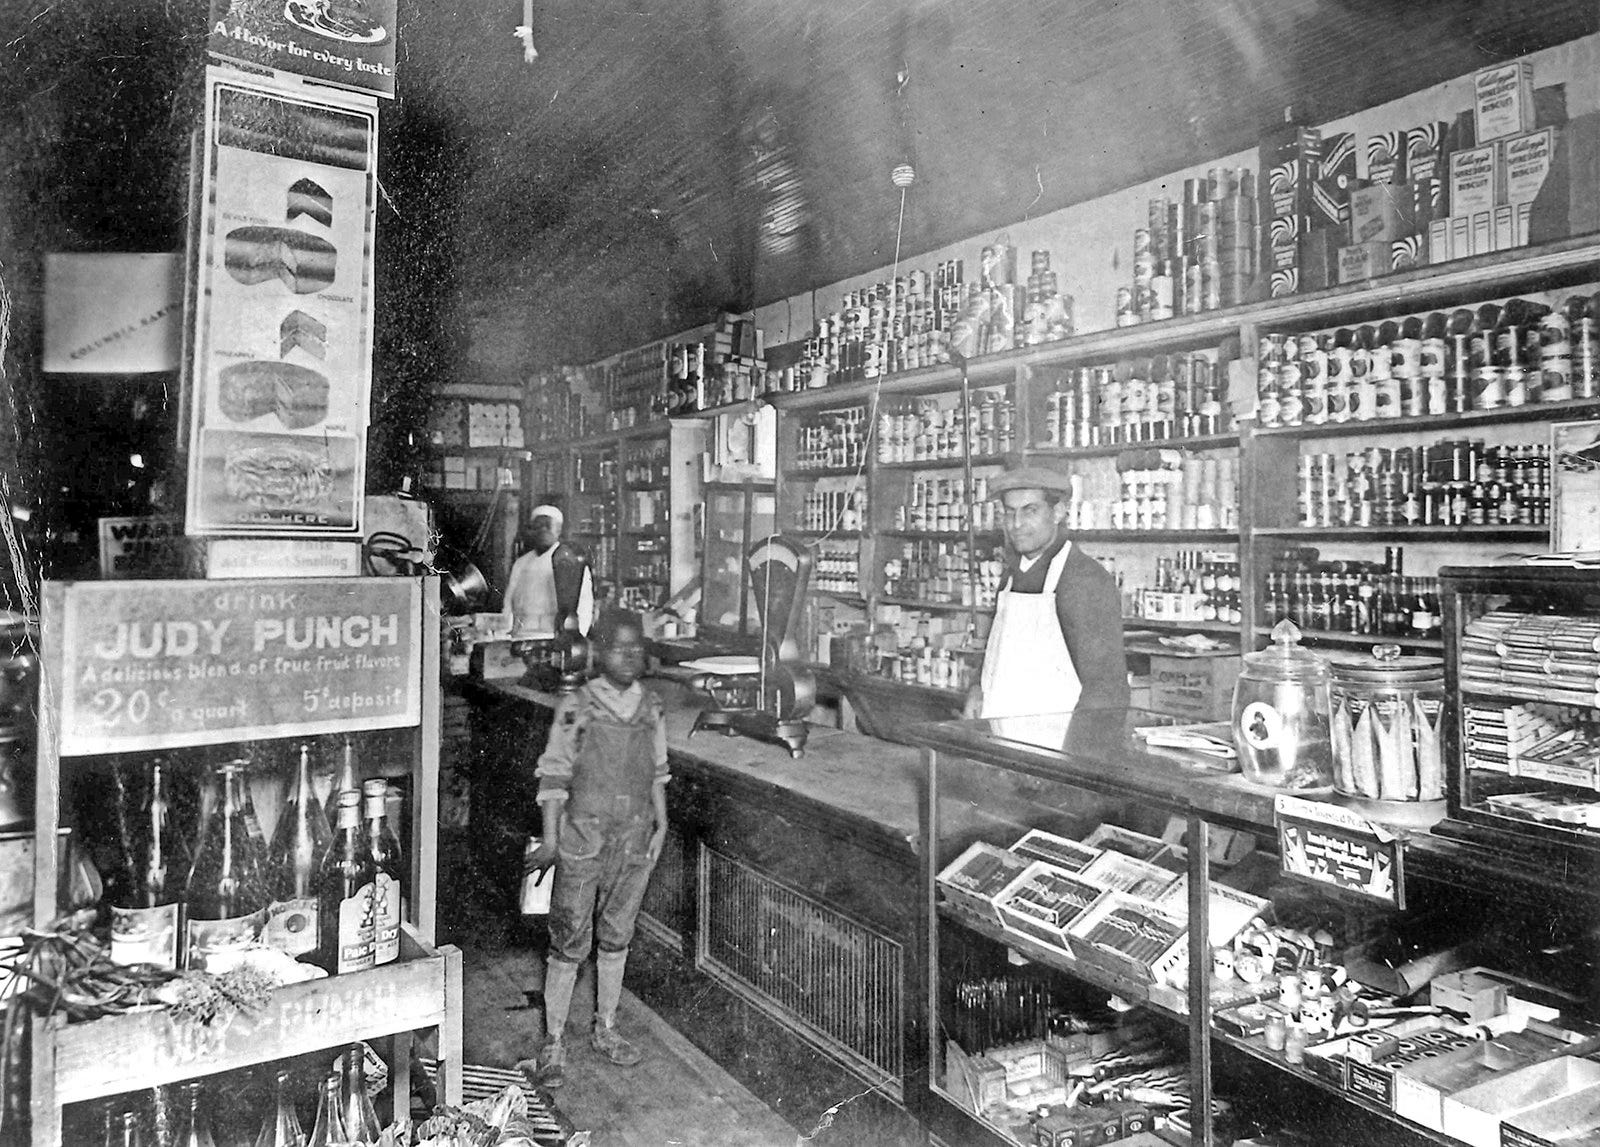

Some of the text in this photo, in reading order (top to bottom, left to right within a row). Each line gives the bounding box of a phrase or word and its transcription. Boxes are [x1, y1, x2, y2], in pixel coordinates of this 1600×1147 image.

[213, 21, 392, 76] A flavor for every taste
[229, 511, 328, 525] OLD HERE
[293, 554, 348, 570] Smelling
[214, 590, 298, 612] drink
[94, 613, 398, 660] JUDY PUNCH
[80, 662, 97, 685] A
[100, 661, 182, 683] delicious
[187, 660, 241, 680] blend
[249, 657, 268, 675] of
[316, 653, 351, 671] fruit
[355, 653, 401, 670] flavors
[329, 684, 402, 713] deposit
[193, 697, 248, 730] quart
[381, 927, 399, 941] Dry
[343, 945, 369, 961] Pale
